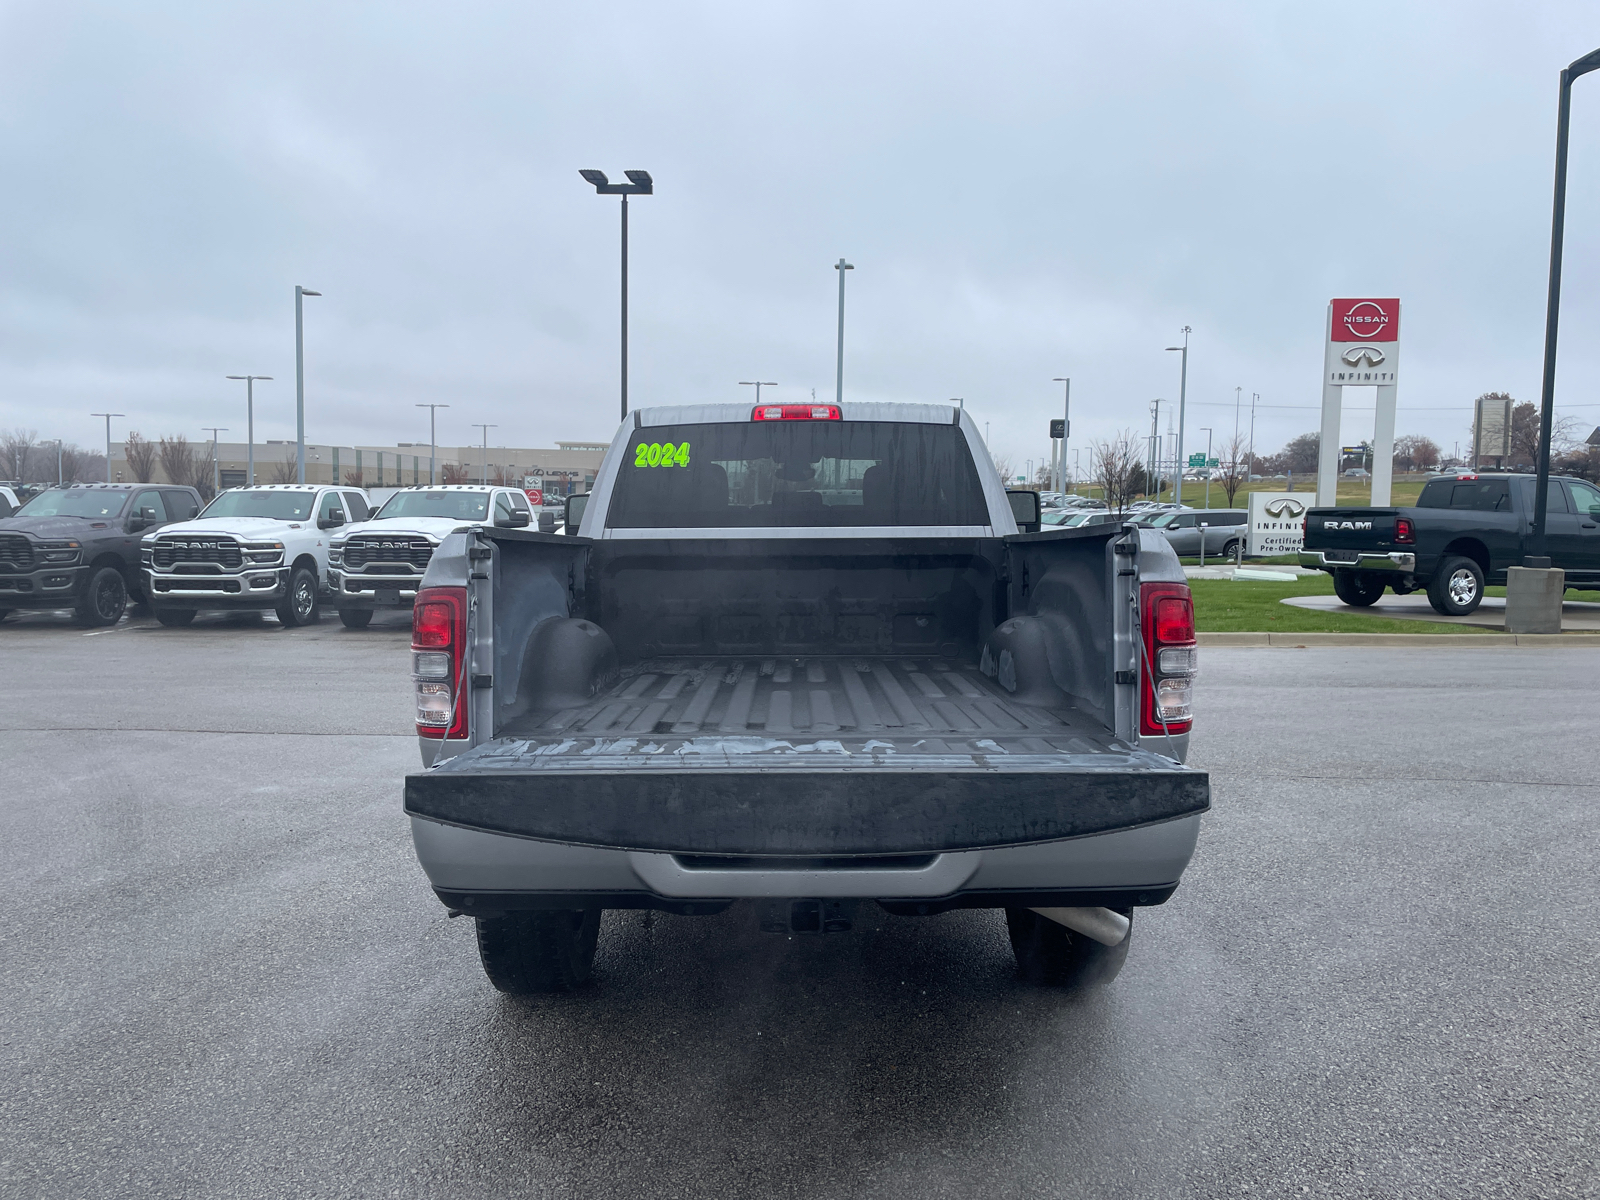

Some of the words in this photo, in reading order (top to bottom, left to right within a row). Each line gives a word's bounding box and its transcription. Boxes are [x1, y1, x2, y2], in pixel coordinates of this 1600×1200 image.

[1331, 372, 1394, 381] INFINITI
[634, 442, 691, 468] 2024
[1257, 522, 1304, 530] INFINIT
[1323, 521, 1372, 530] RAM
[365, 541, 409, 549] RAM
[1265, 537, 1302, 545] Certified
[1260, 544, 1301, 552] Pre-Owne
